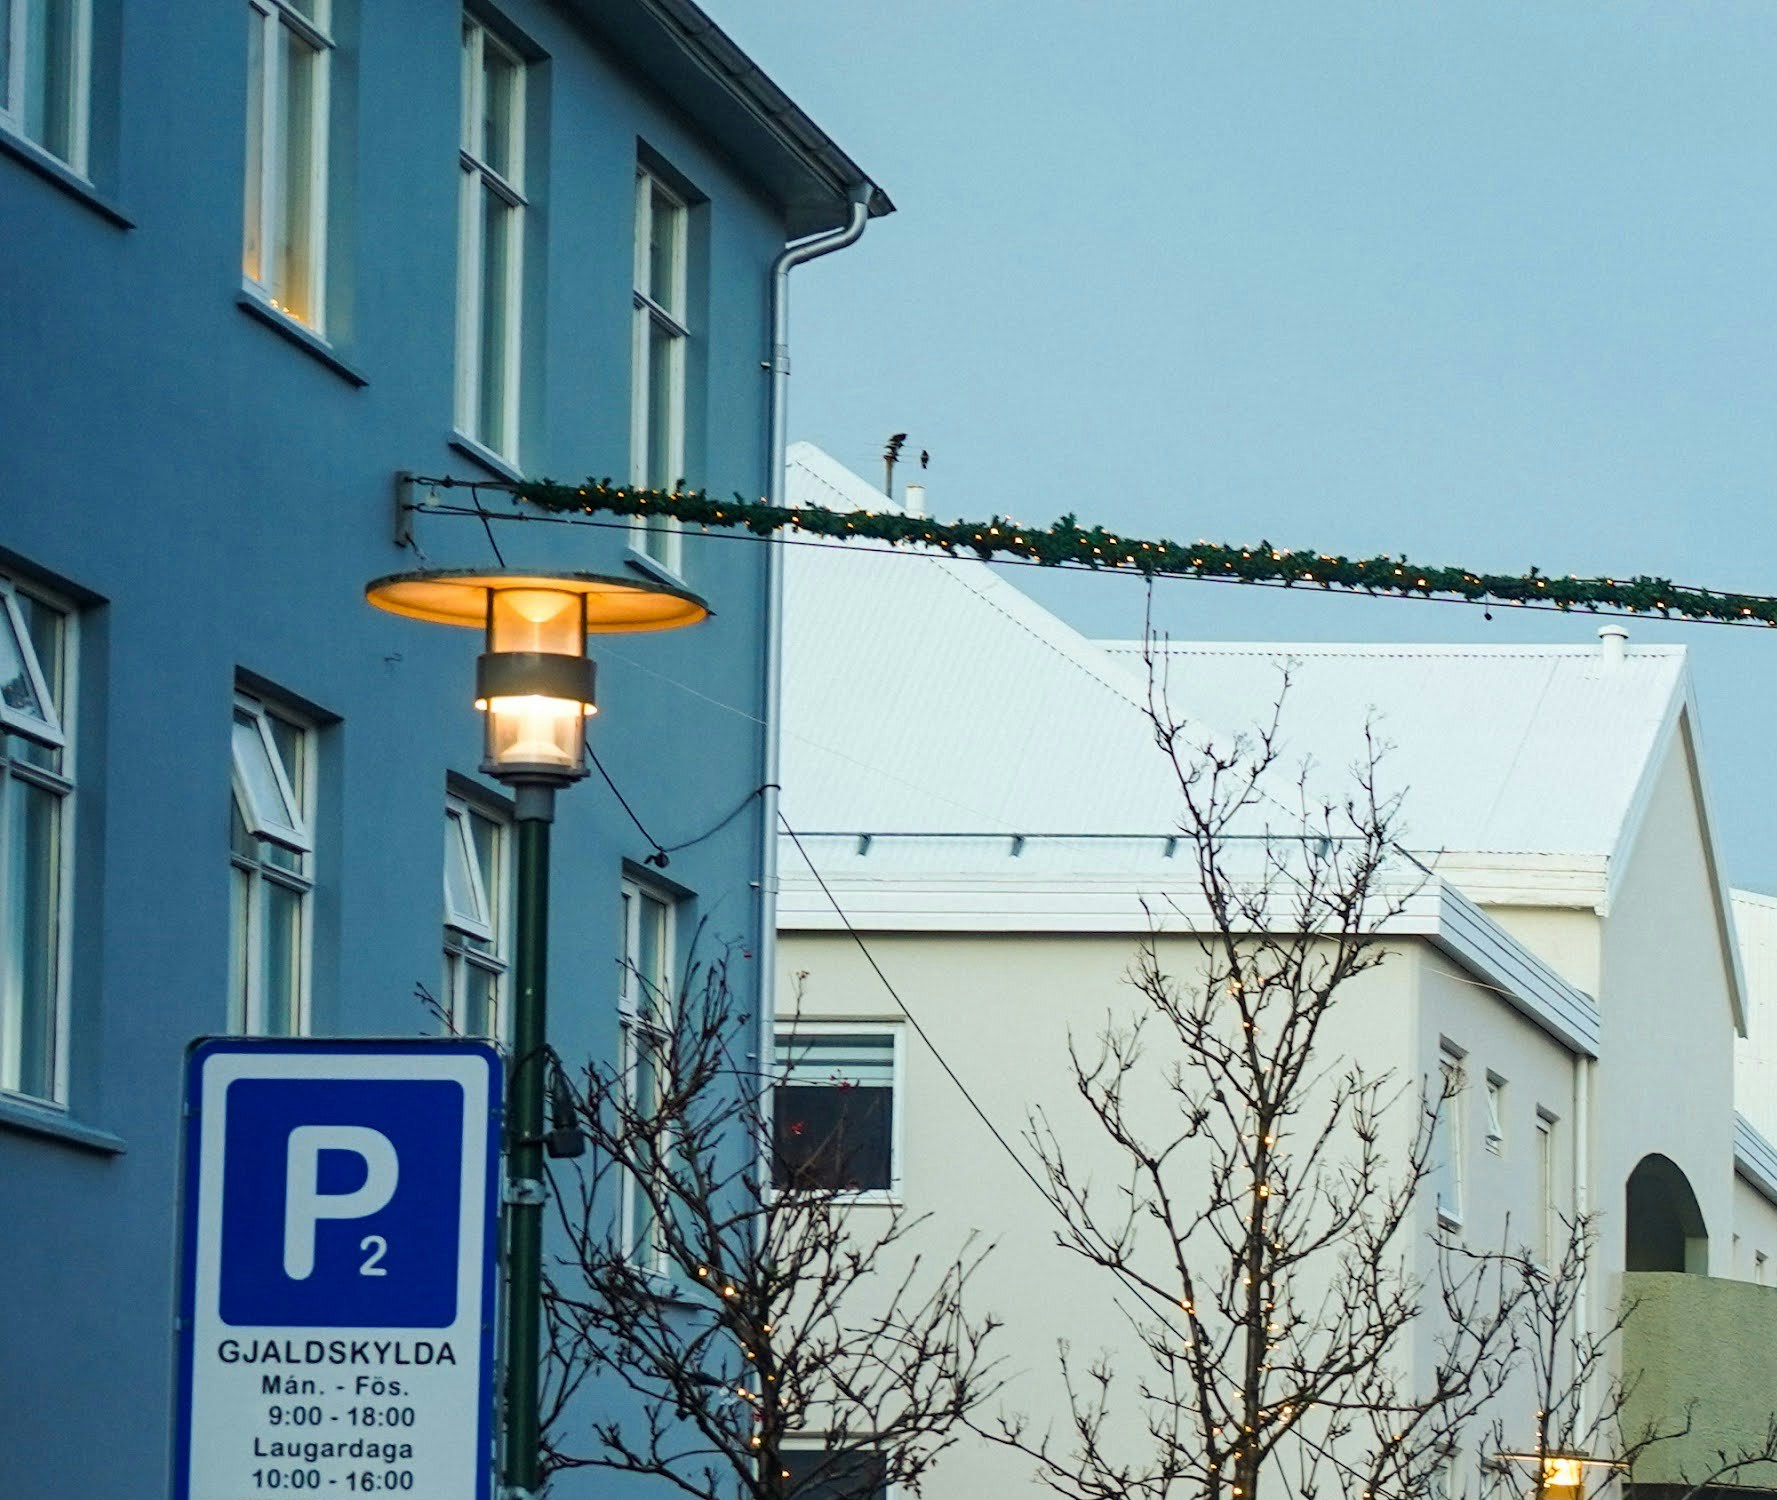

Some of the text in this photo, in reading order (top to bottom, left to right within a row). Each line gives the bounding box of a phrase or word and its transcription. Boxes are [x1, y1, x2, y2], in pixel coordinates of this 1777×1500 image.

[284, 1125, 399, 1280] P 2
[218, 1339, 456, 1366] GJALDSKYLDA
[262, 1375, 325, 1395] Mán.
[355, 1375, 409, 1396] Fös.
[269, 1406, 322, 1426] 9:00
[348, 1407, 415, 1427] 18:00
[253, 1437, 413, 1464] Laugardaga
[253, 1469, 321, 1490] 10:00
[346, 1470, 414, 1492] 16:00
